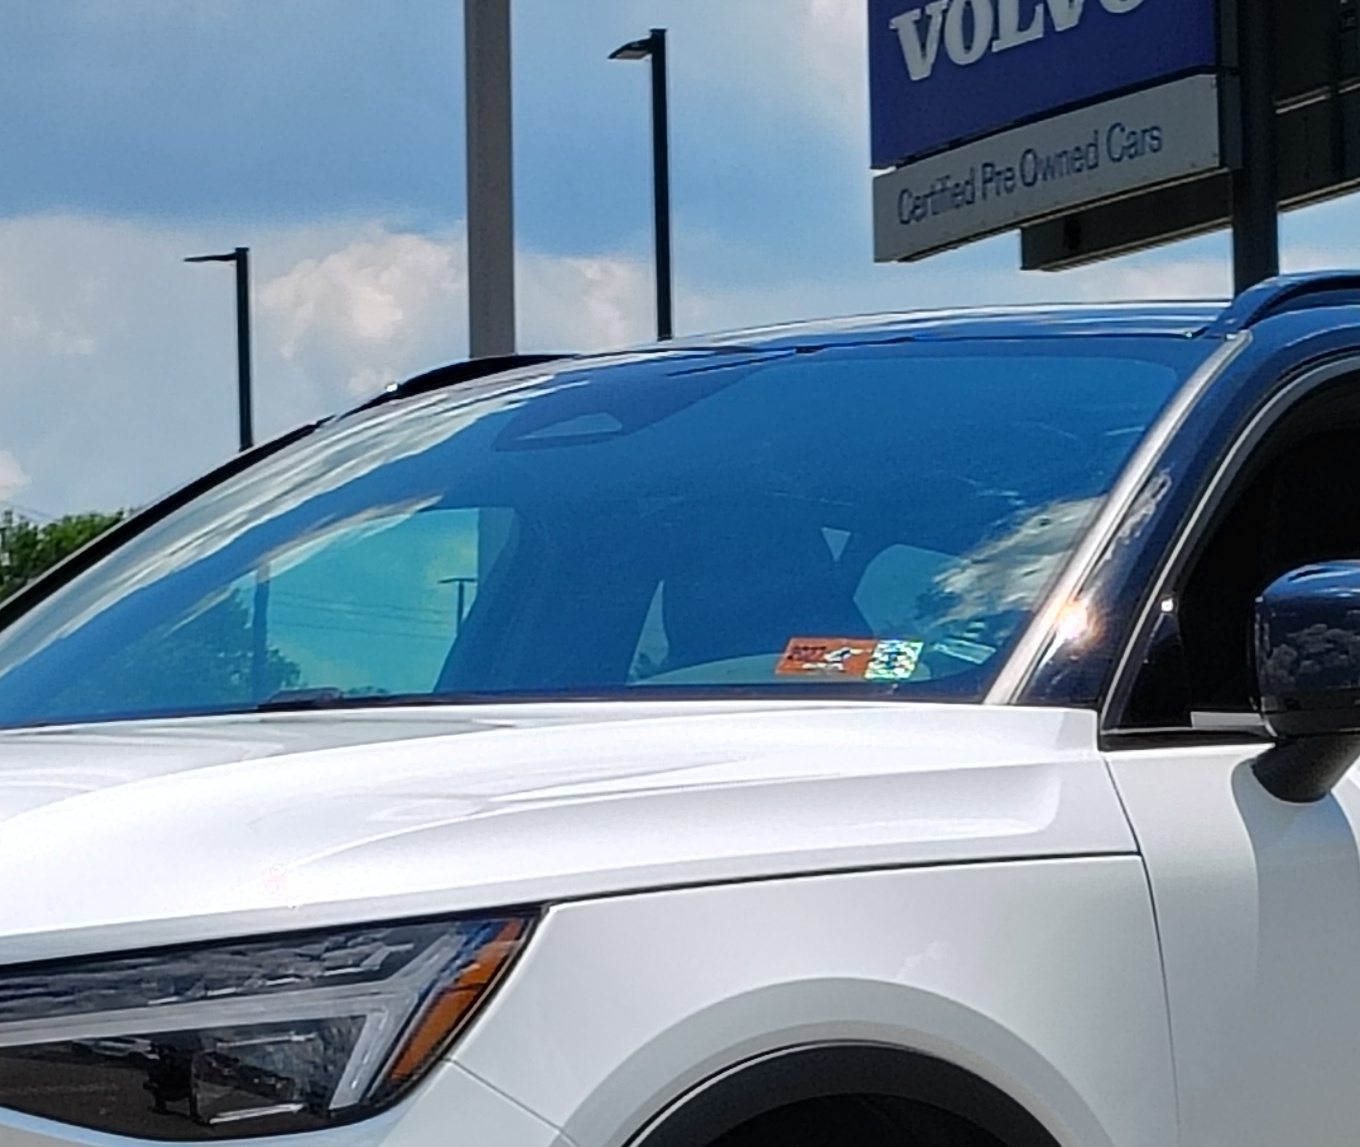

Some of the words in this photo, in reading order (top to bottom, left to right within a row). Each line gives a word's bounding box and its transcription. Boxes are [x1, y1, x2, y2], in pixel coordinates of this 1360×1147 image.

[889, 0, 1145, 81] VOL
[897, 166, 976, 226] Certified
[981, 162, 1017, 200] Pre
[1019, 128, 1100, 188] Owned
[1106, 122, 1163, 163] Cars
